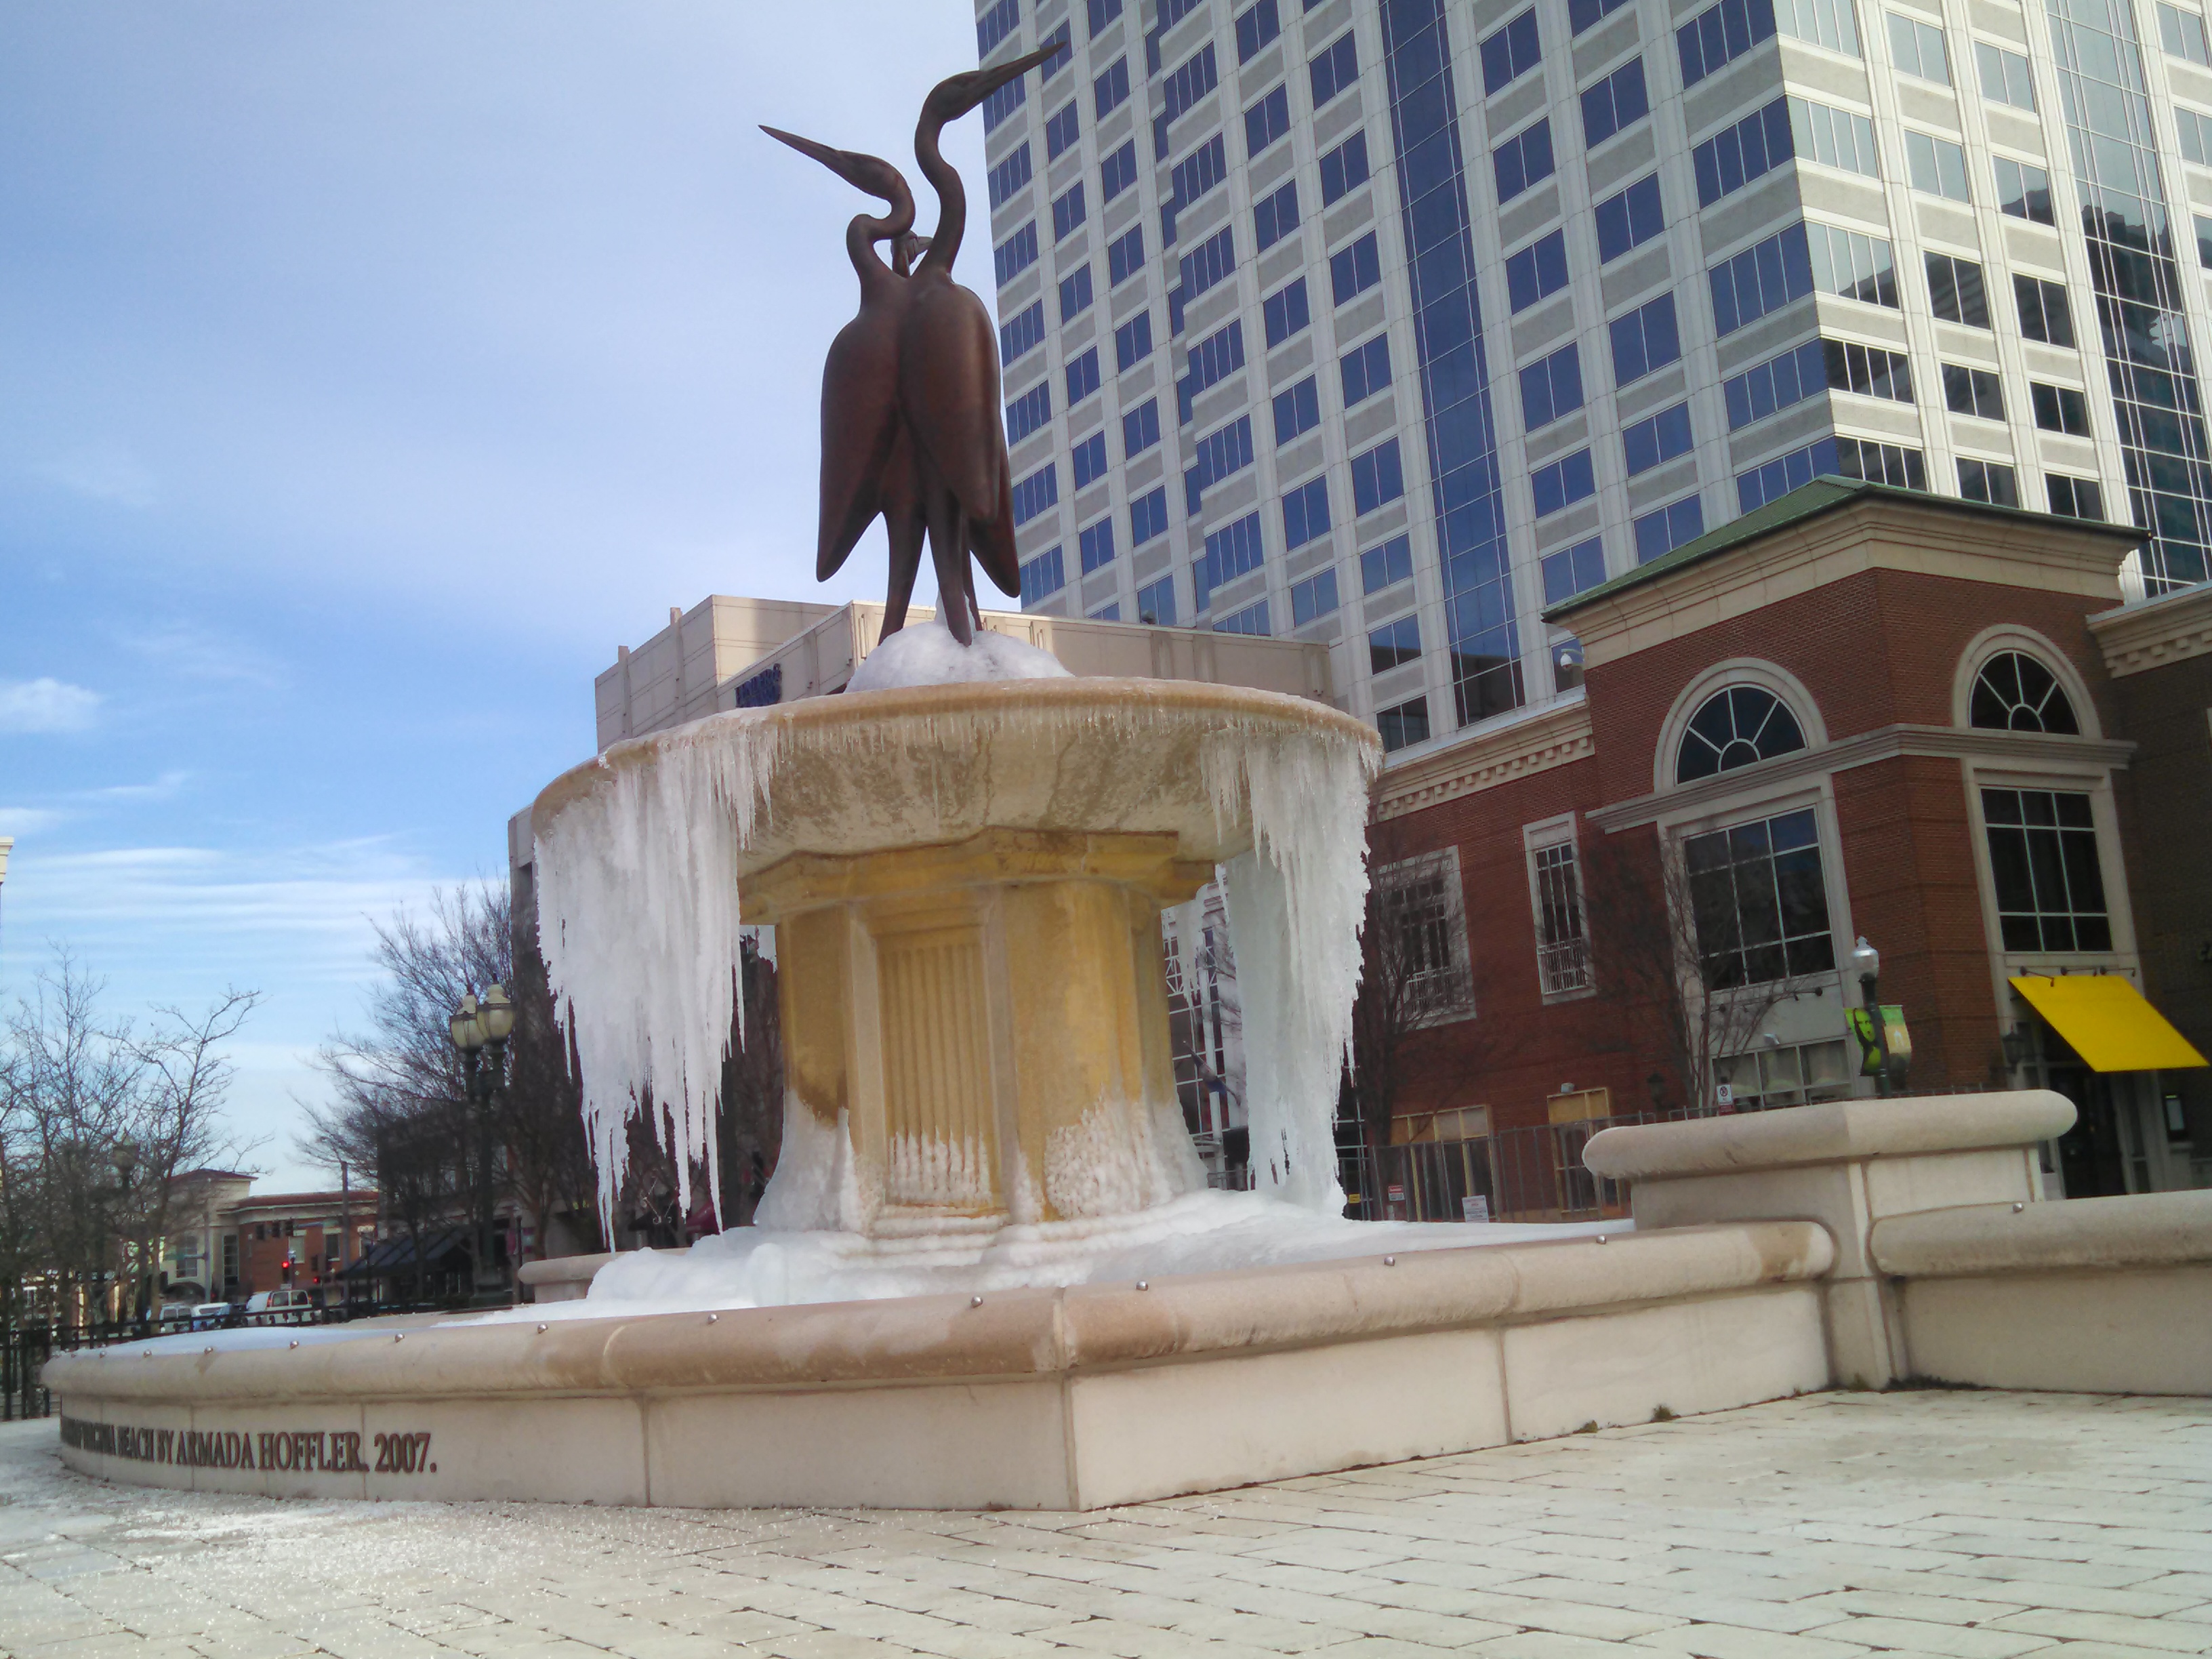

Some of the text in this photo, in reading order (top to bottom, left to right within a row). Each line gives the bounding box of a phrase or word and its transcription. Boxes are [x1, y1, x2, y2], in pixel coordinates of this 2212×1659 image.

[157, 1429, 174, 1465] BY
[176, 1431, 255, 1469] ARMADA
[374, 1433, 437, 1473] 2007.
